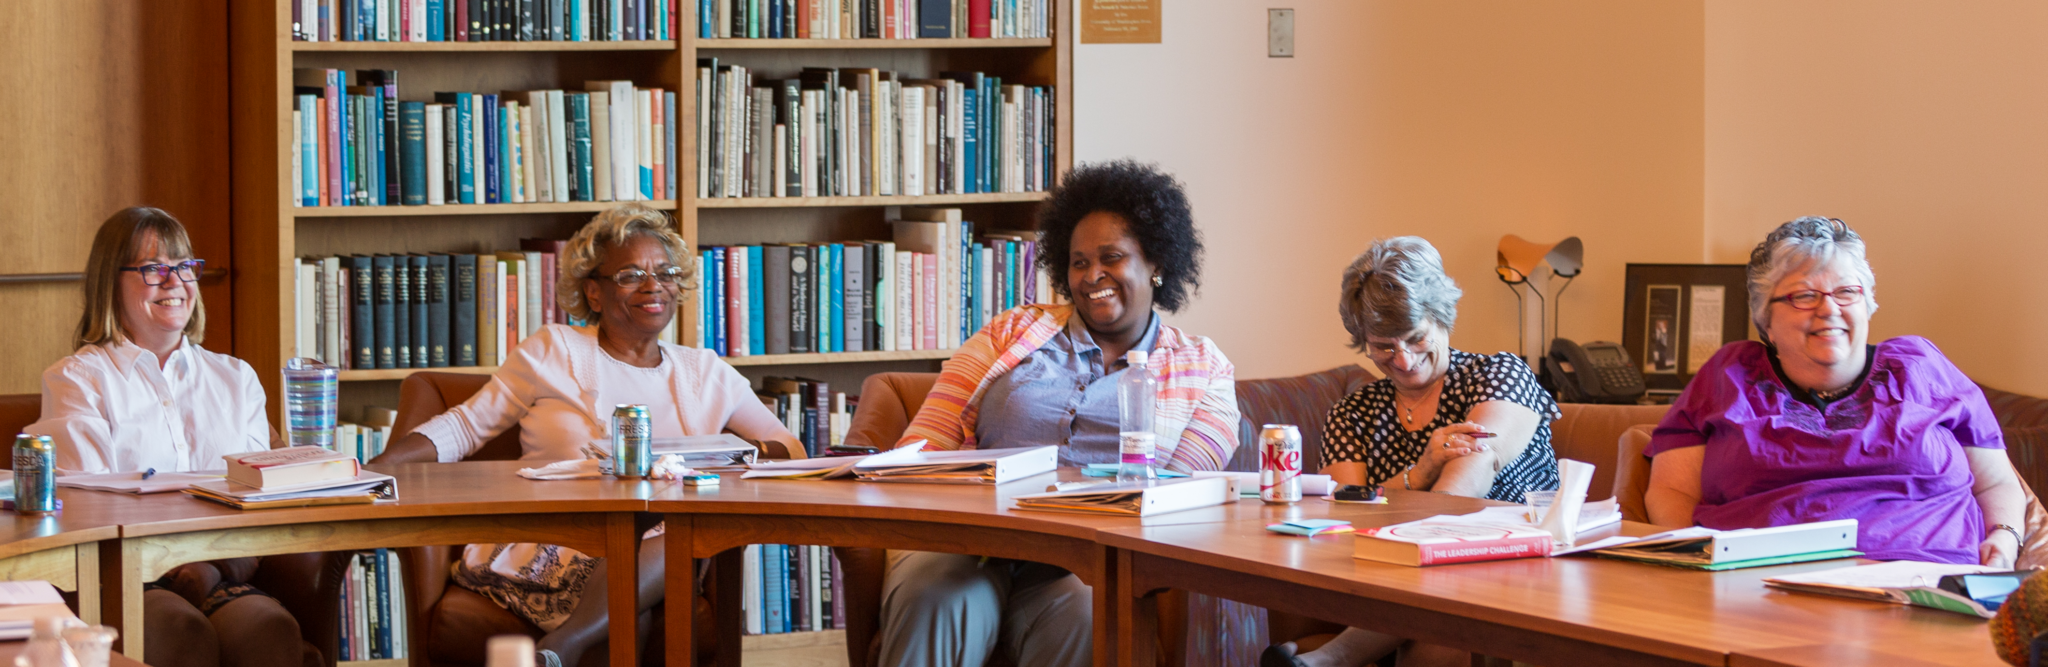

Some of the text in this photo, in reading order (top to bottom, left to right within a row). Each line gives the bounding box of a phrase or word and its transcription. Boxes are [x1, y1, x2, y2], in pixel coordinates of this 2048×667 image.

[460, 112, 473, 173] Psycholinguistics
[1259, 444, 1299, 471] oke
[1433, 549, 1447, 558] THE
[1447, 547, 1489, 558] LEADERSHIP
[1489, 544, 1528, 554] CHALLENGE
